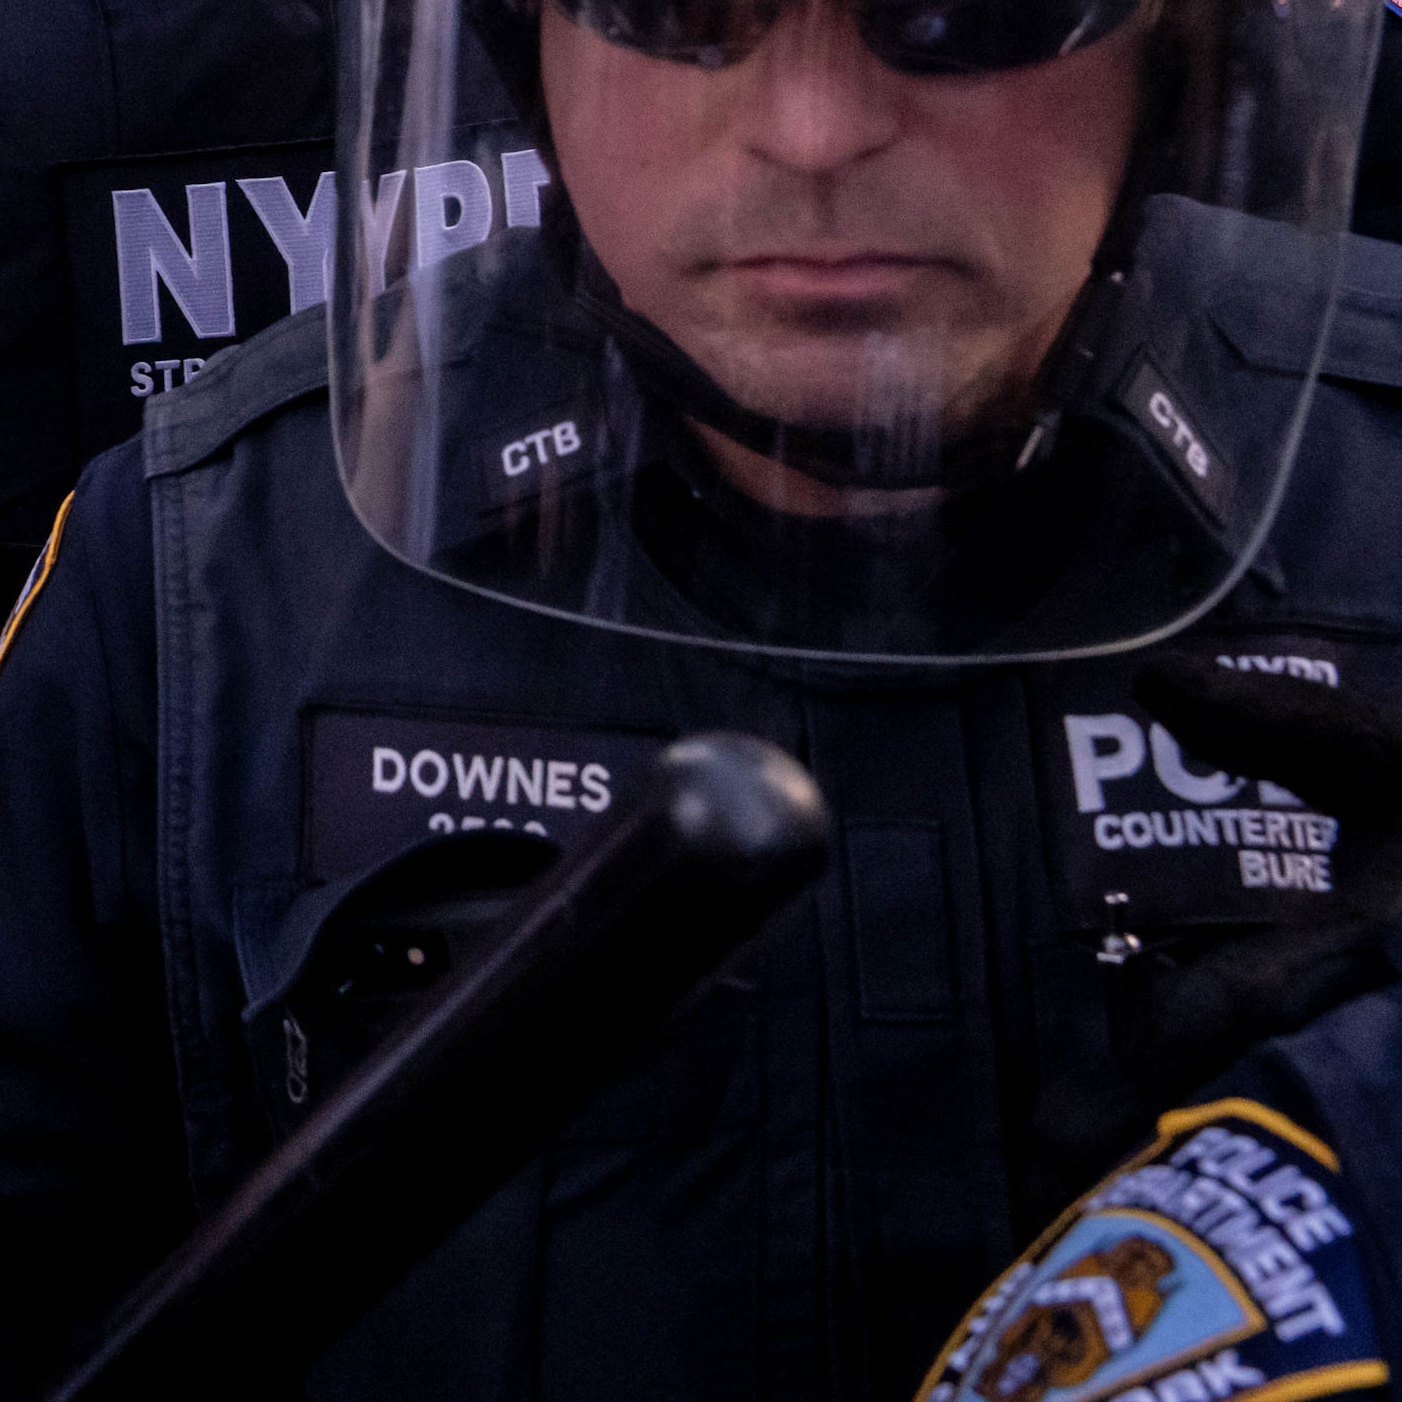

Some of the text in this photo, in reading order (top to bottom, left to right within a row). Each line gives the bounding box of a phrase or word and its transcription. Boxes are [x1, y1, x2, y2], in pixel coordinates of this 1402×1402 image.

[501, 421, 582, 478] CTB
[1148, 391, 1210, 477] CTB
[372, 746, 612, 814] DOWNES
[1238, 849, 1334, 893] BURE
[1168, 1125, 1356, 1254] POLICE
